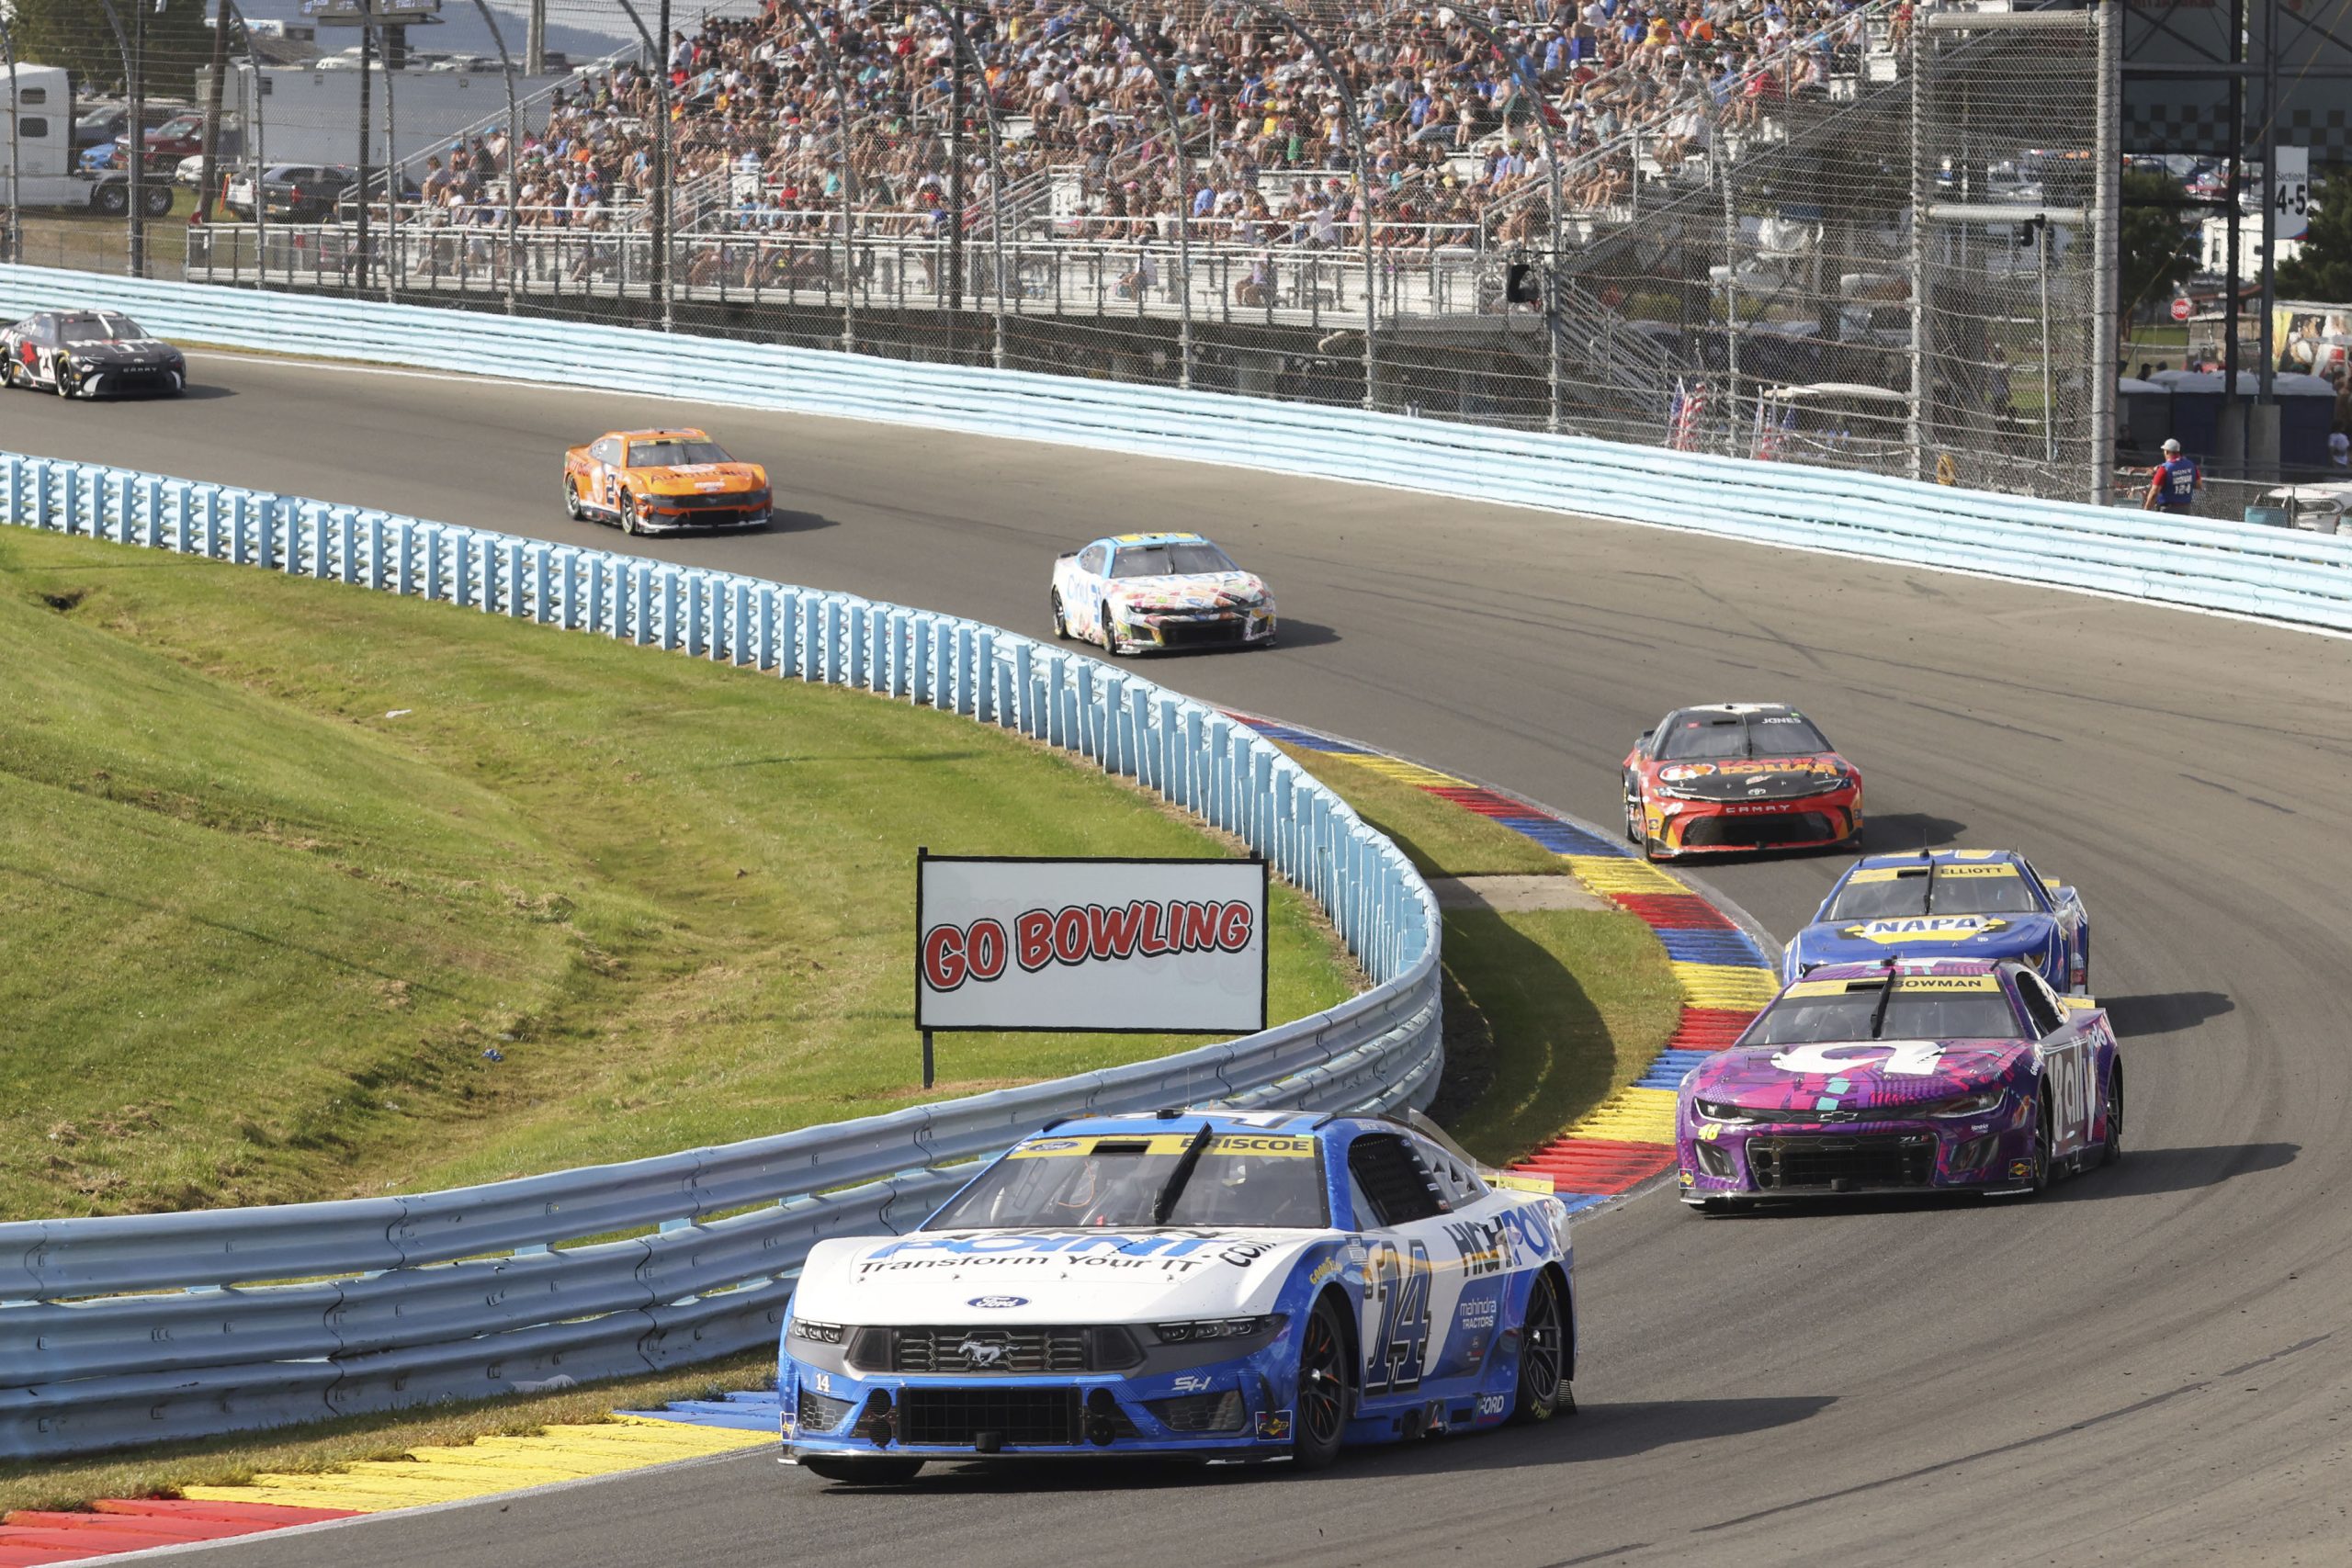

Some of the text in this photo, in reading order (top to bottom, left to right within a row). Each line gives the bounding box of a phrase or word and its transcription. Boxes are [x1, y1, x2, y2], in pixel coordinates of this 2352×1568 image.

[2276, 185, 2306, 215] 4-5
[2174, 483, 2192, 495] 124
[1725, 804, 1791, 814] CAMRY
[1940, 867, 2003, 875] ELLIOTT
[1874, 918, 1978, 933] NAPA
[922, 900, 1253, 992] GO BOWLING
[1894, 980, 1982, 988] BOWMAN
[860, 1255, 1203, 1274] Transform Your IT
[976, 1295, 1020, 1309] Ford
[1460, 1296, 1497, 1316] mahindra
[1363, 1239, 1432, 1397] 14
[1463, 1315, 1494, 1330] TRACTORS
[816, 1372, 831, 1393] 14
